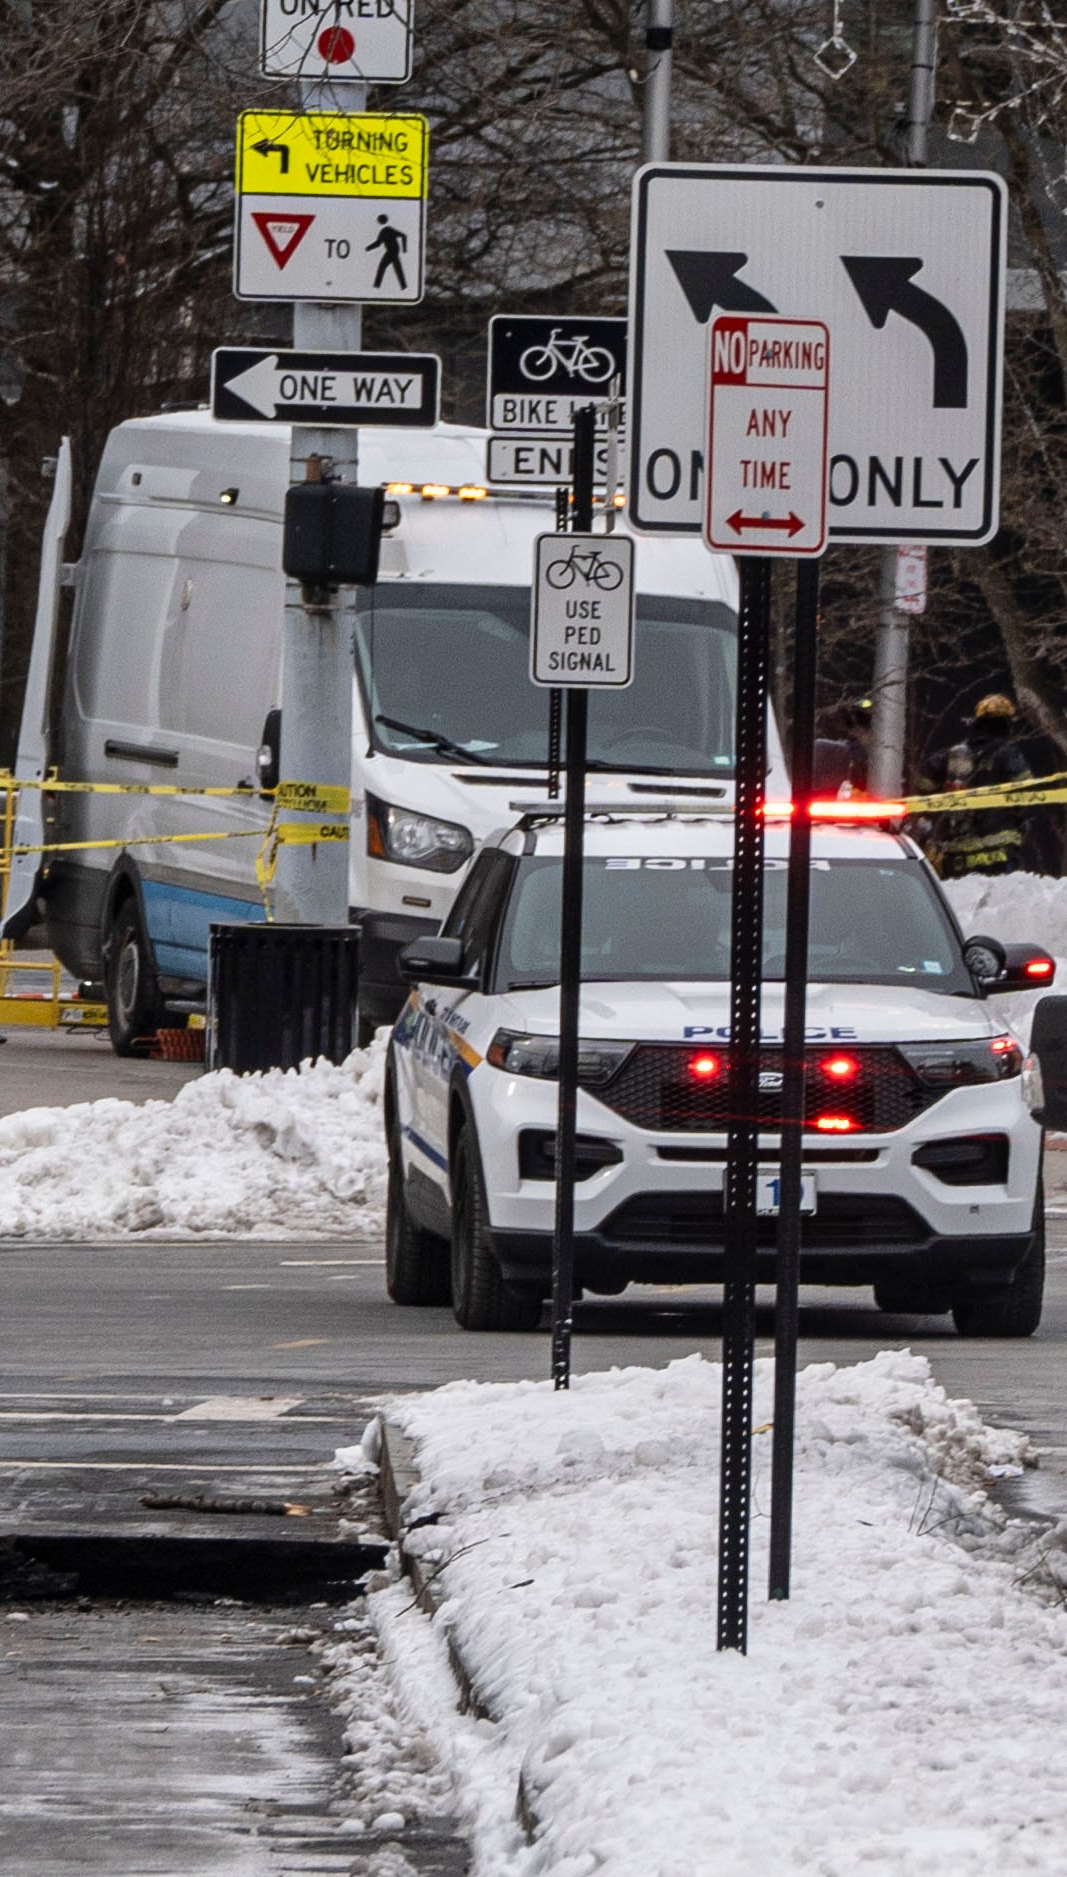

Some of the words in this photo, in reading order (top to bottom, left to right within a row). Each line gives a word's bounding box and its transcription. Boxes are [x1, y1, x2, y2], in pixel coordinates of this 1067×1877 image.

[335, 0, 394, 18] RED
[313, 130, 408, 153] TURNING
[306, 163, 413, 186] VEHICLES
[324, 238, 351, 259] TO
[713, 330, 745, 375] NO
[748, 337, 825, 371] PARKING
[279, 375, 337, 401] ONE
[353, 377, 413, 404] WAY
[503, 399, 557, 424] BIKE
[746, 408, 792, 438] ANY
[740, 460, 792, 490] TIME
[829, 453, 981, 509] ONLY
[565, 600, 602, 620] USE
[564, 626, 601, 646] PED
[548, 651, 616, 673] SIGNAL
